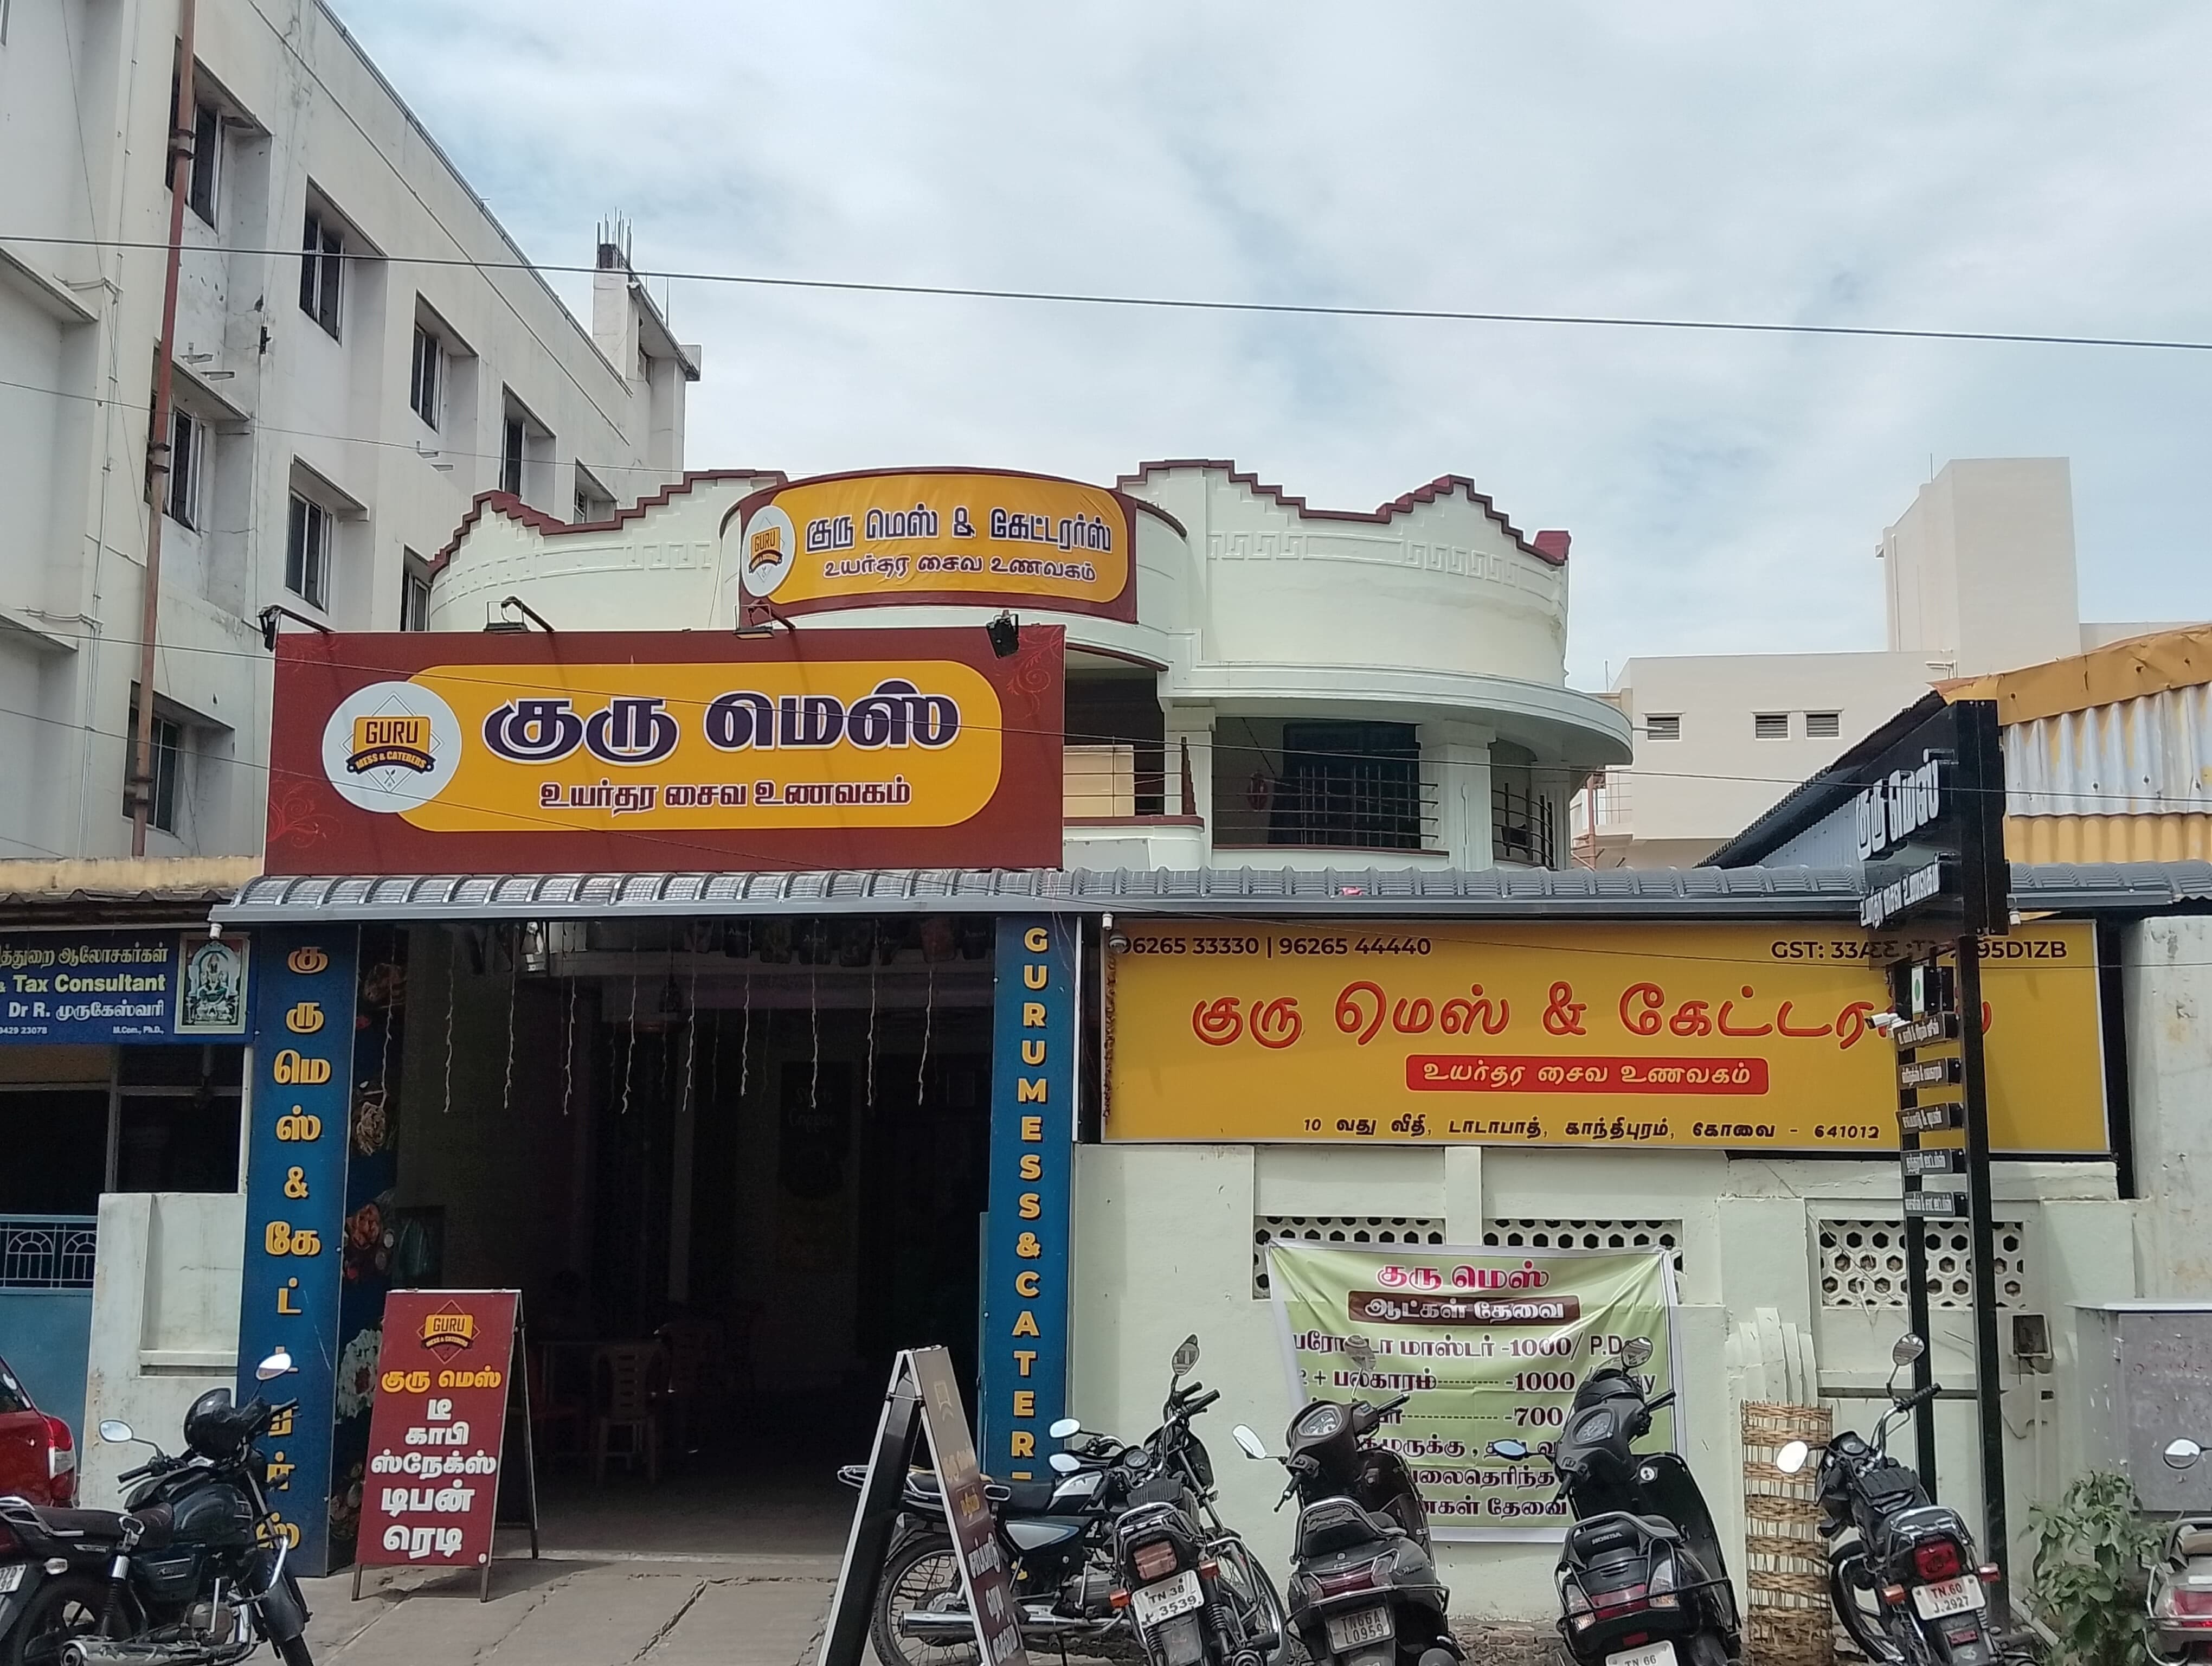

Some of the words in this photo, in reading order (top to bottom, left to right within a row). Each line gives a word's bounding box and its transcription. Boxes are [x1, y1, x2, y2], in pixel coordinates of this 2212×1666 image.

[755, 530, 775, 552] GURU
[806, 515, 854, 554] குரு
[866, 504, 938, 540] மெஸ்
[953, 506, 975, 537] &
[823, 554, 911, 579] உயர்தர
[916, 556, 983, 573] சைவ
[989, 556, 1096, 583] உணவகம்
[481, 696, 679, 762] குரு
[704, 678, 961, 753] மெஸ்
[366, 721, 418, 744] GURU
[356, 753, 378, 769] MESS
[540, 776, 659, 816] உயர்தர
[664, 783, 747, 806] சைவ
[753, 775, 911, 806] உணவகம்
[0, 943, 55, 970] த்துறை
[58, 941, 169, 966] ஆலோசகர்கள்
[1192, 937, 1259, 954] 33330
[1279, 938, 1348, 956] 96265
[1354, 938, 1432, 956] 44440
[1771, 941, 1824, 959] GST:
[12, 974, 49, 993] Tax
[55, 973, 166, 992] Consultant
[8, 1002, 29, 1018] Dr
[33, 1002, 50, 1018] R.
[56, 998, 165, 1022] முருகேஸ்வரி
[1191, 995, 1304, 1049] குரு
[1334, 979, 1511, 1046] மெஸ்
[1541, 980, 1587, 1036] &
[1423, 1058, 1526, 1087] உயர்தர
[1538, 1063, 1609, 1083] சைவ
[1621, 1061, 1752, 1085] உணவகம்
[1303, 1118, 1321, 1132] 10
[1336, 1118, 1377, 1136] வது
[1448, 1116, 1548, 1138] டாடாபாத்,
[1565, 1116, 1675, 1141] காந்திபுரம்,
[1692, 1120, 1775, 1139] கோவை
[1814, 1124, 1880, 1139] 641012
[1377, 1264, 1442, 1291] குரு
[1451, 1259, 1551, 1290] மெஸ்
[1362, 1297, 1467, 1320] ஆட்கள்
[1475, 1300, 1565, 1324] தேவை
[433, 1318, 465, 1331] GURU
[1400, 1334, 1496, 1357] மாஸ்டர்
[381, 1370, 430, 1393] குரு
[438, 1366, 502, 1389] மெஸ்
[427, 1398, 452, 1421] டீ
[405, 1421, 471, 1445] காபி
[371, 1449, 497, 1480] ஸ்நேக்ஸ்
[381, 1479, 475, 1517] டிபன்
[1488, 1498, 1567, 1519] தேவை
[382, 1525, 463, 1559] ரெடி
[1592, 1532, 1623, 1545] HONDA
[1149, 1591, 1167, 1604] TN
[1170, 1585, 1185, 1596] 38
[1159, 1595, 1197, 1616] 3539
